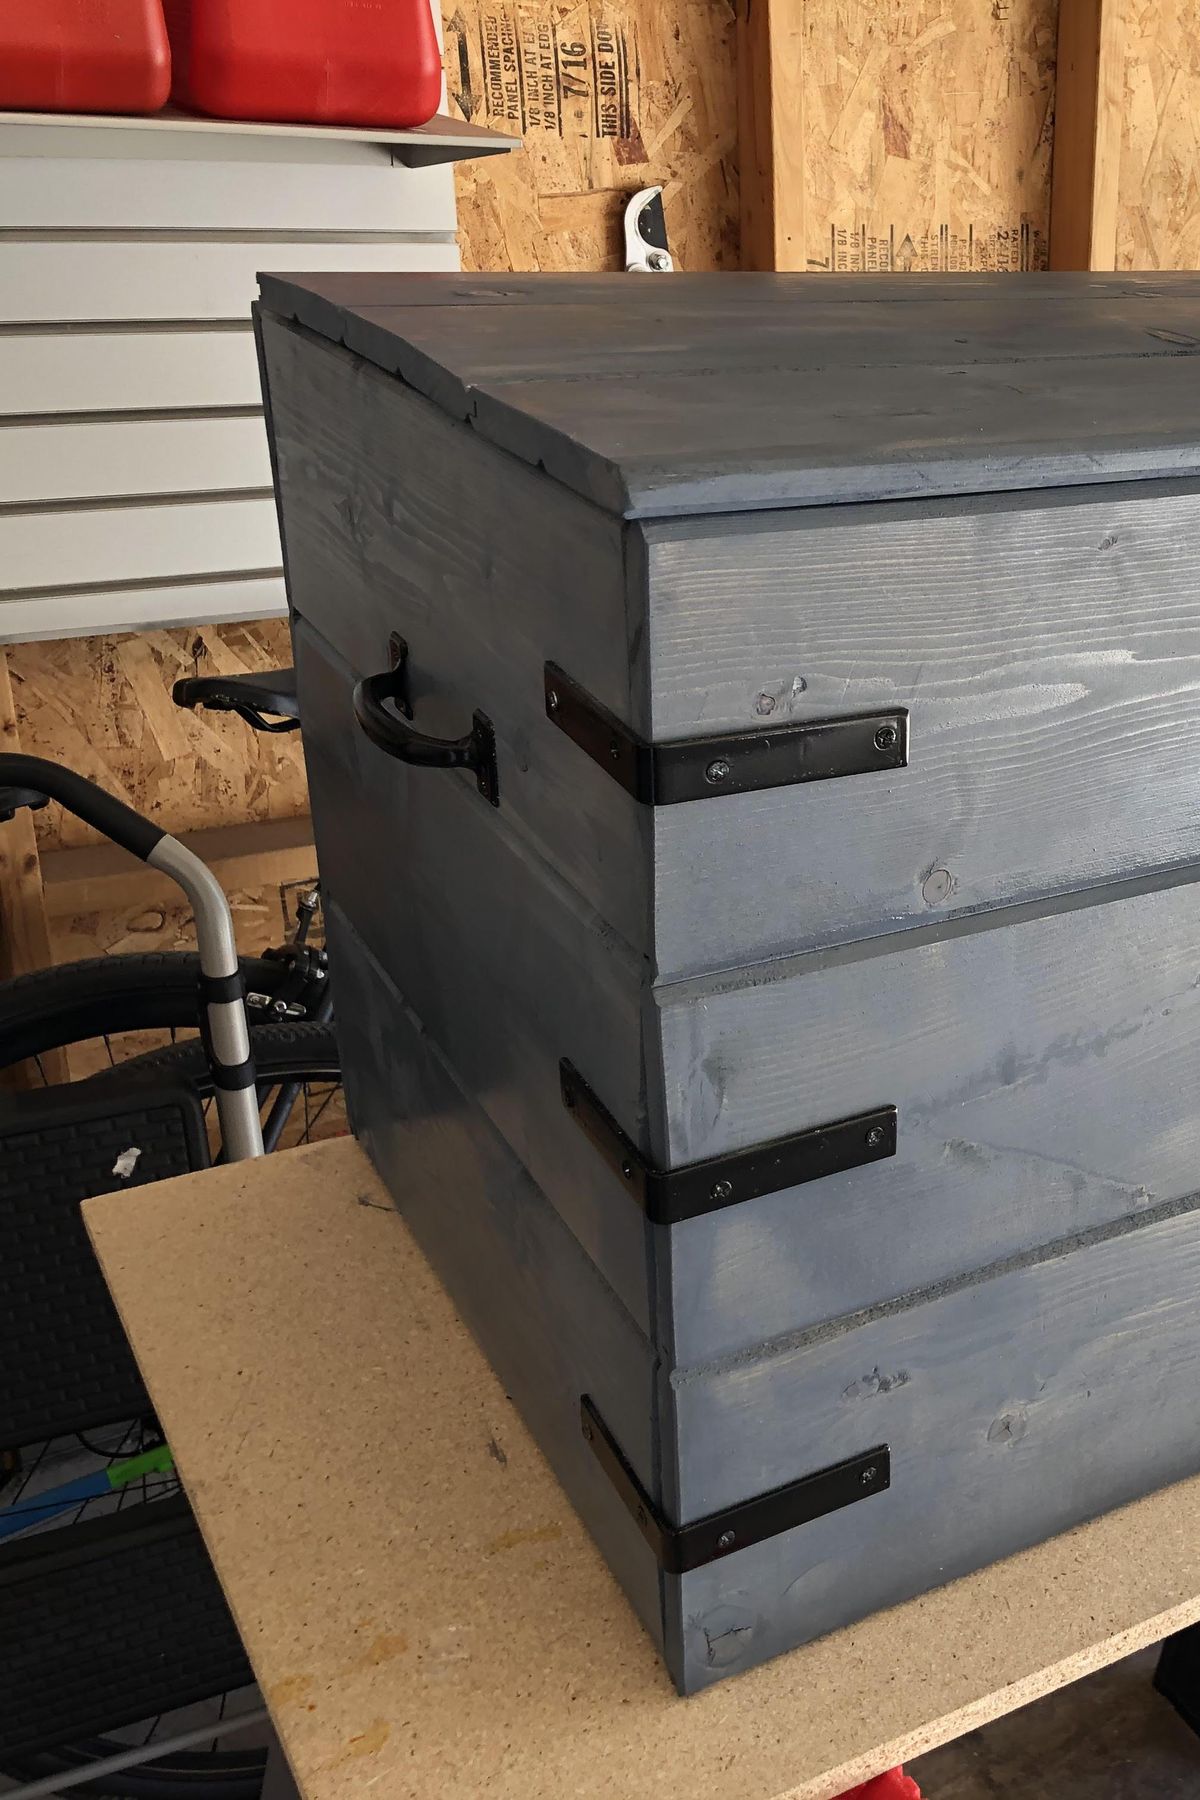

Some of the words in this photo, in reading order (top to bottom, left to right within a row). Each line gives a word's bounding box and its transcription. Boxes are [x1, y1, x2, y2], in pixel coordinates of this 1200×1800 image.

[485, 15, 504, 117] RECOMMENDED
[523, 49, 537, 64] AT
[539, 54, 552, 70] AT
[560, 42, 588, 99] 7/16
[525, 71, 539, 101] INCH
[541, 75, 554, 105] INCH
[598, 60, 616, 96] SIDE
[505, 78, 519, 120] PANEL
[528, 107, 541, 127] 1/8
[543, 111, 556, 130] 1/8
[600, 103, 617, 138] THIS
[837, 229, 847, 246] 1/8
[850, 231, 859, 249] 1/8
[920, 235, 929, 260] THIS
[1011, 229, 1019, 264] RATED
[867, 237, 877, 272] PANEL
[879, 239, 889, 272] RECO
